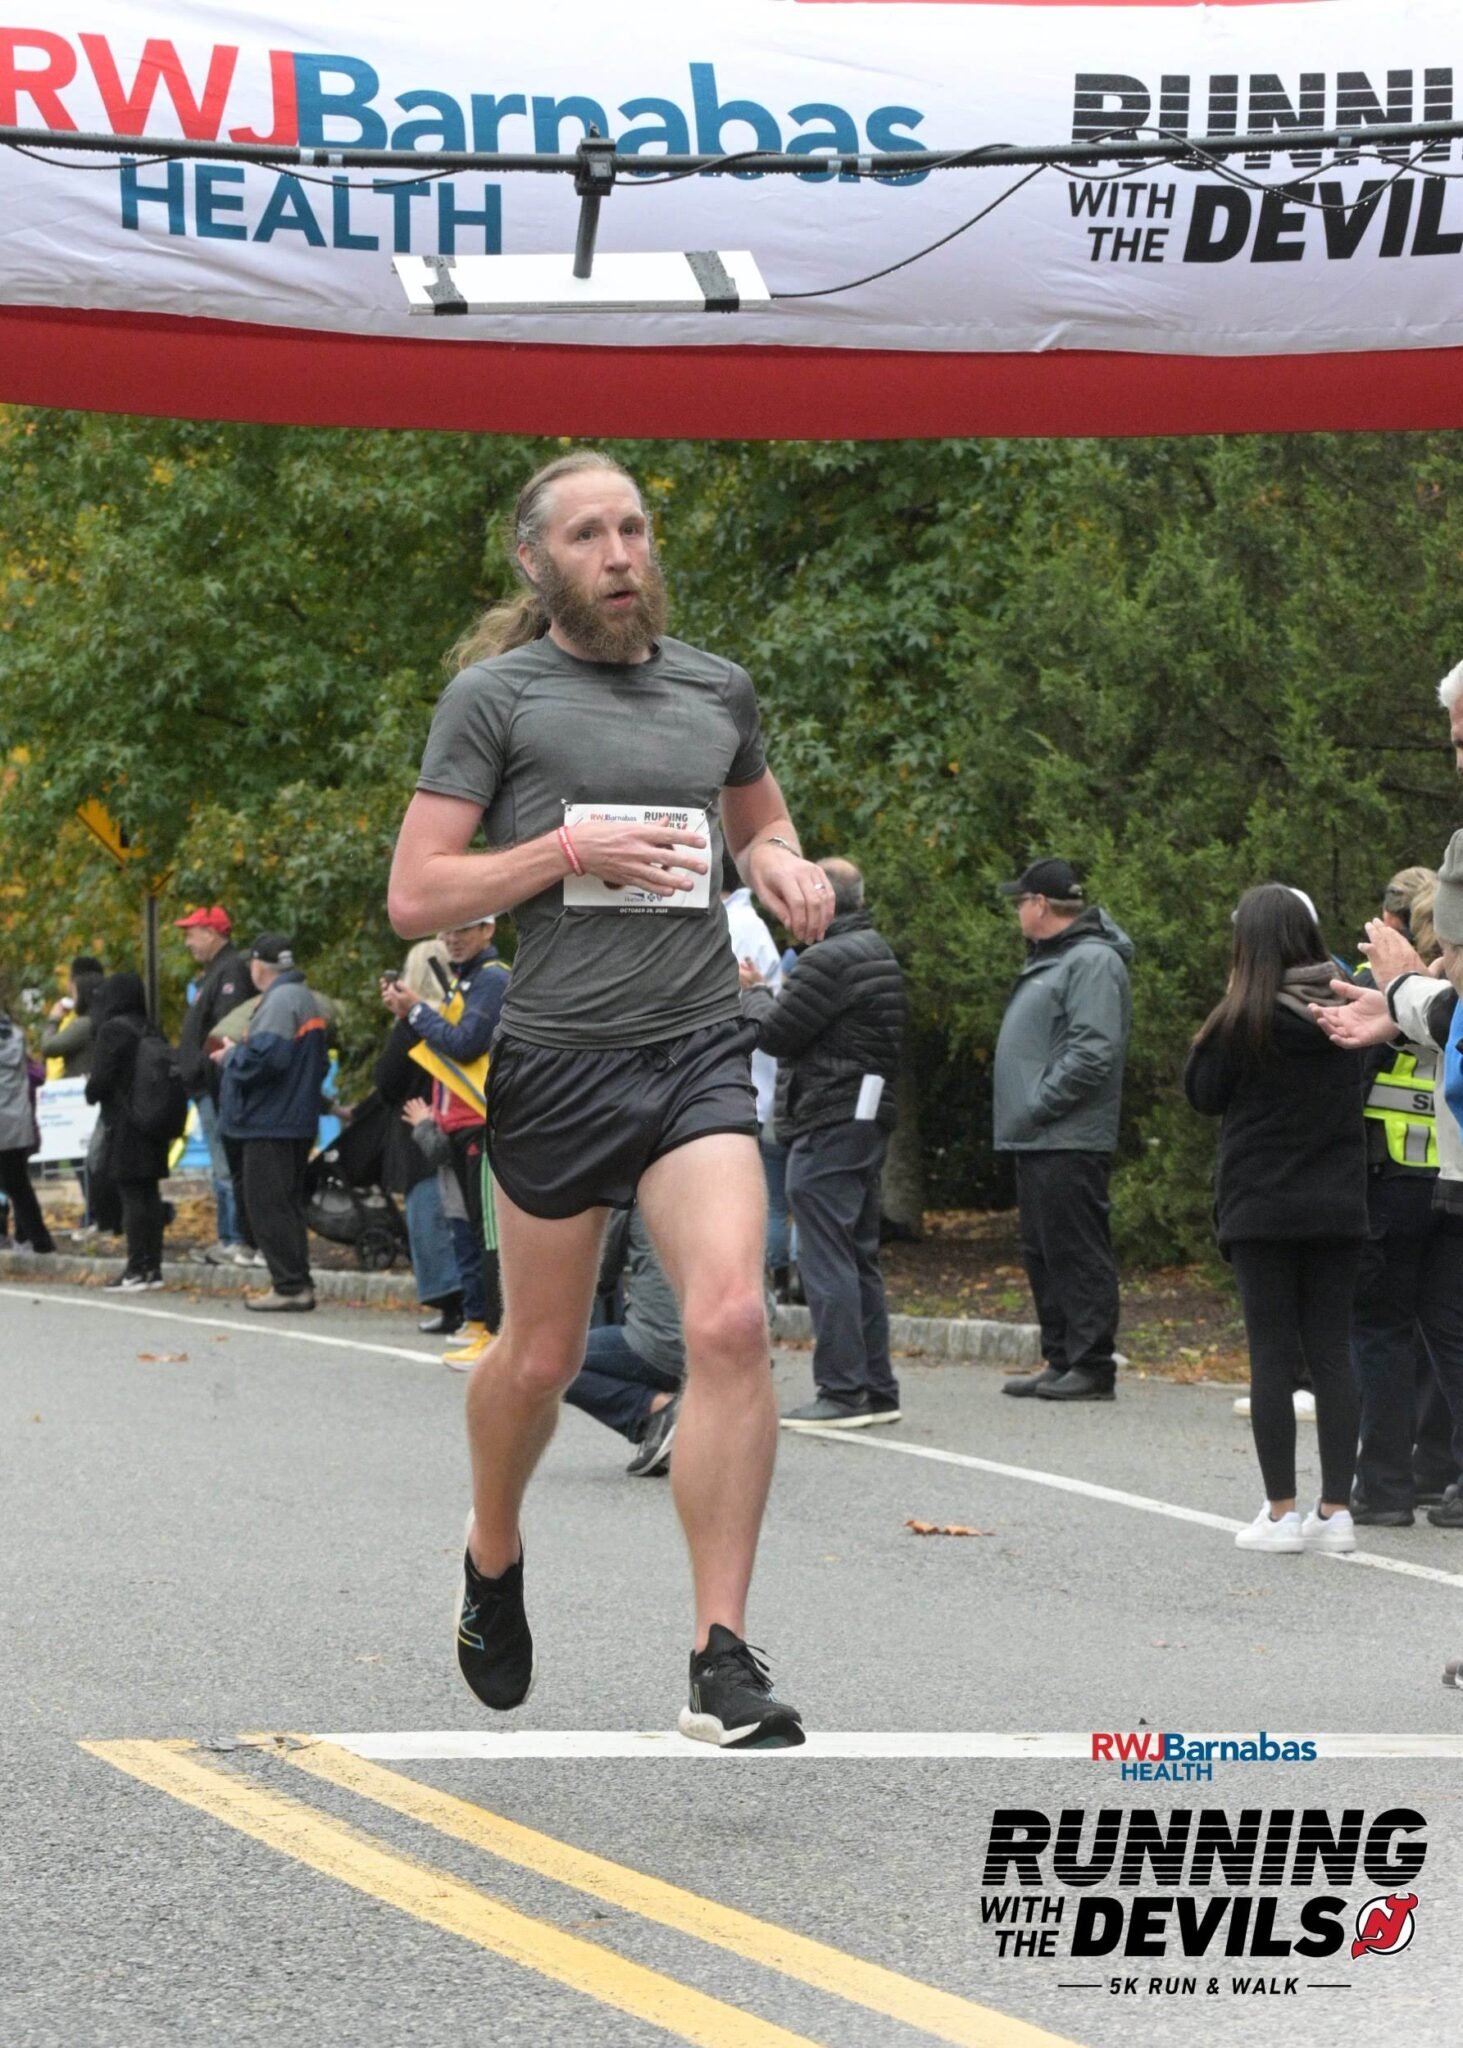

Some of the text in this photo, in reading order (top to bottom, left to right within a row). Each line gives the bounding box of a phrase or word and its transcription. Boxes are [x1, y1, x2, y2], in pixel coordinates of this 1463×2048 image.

[0, 26, 931, 187] RWJBarnabas
[1071, 66, 1463, 171] RUNNI
[119, 156, 502, 256] HEALTH
[1068, 180, 1463, 263] WITH DEVIL
[1087, 227, 1169, 263] THE
[643, 811, 689, 822] RUNNING
[1412, 1093, 1435, 1112] S
